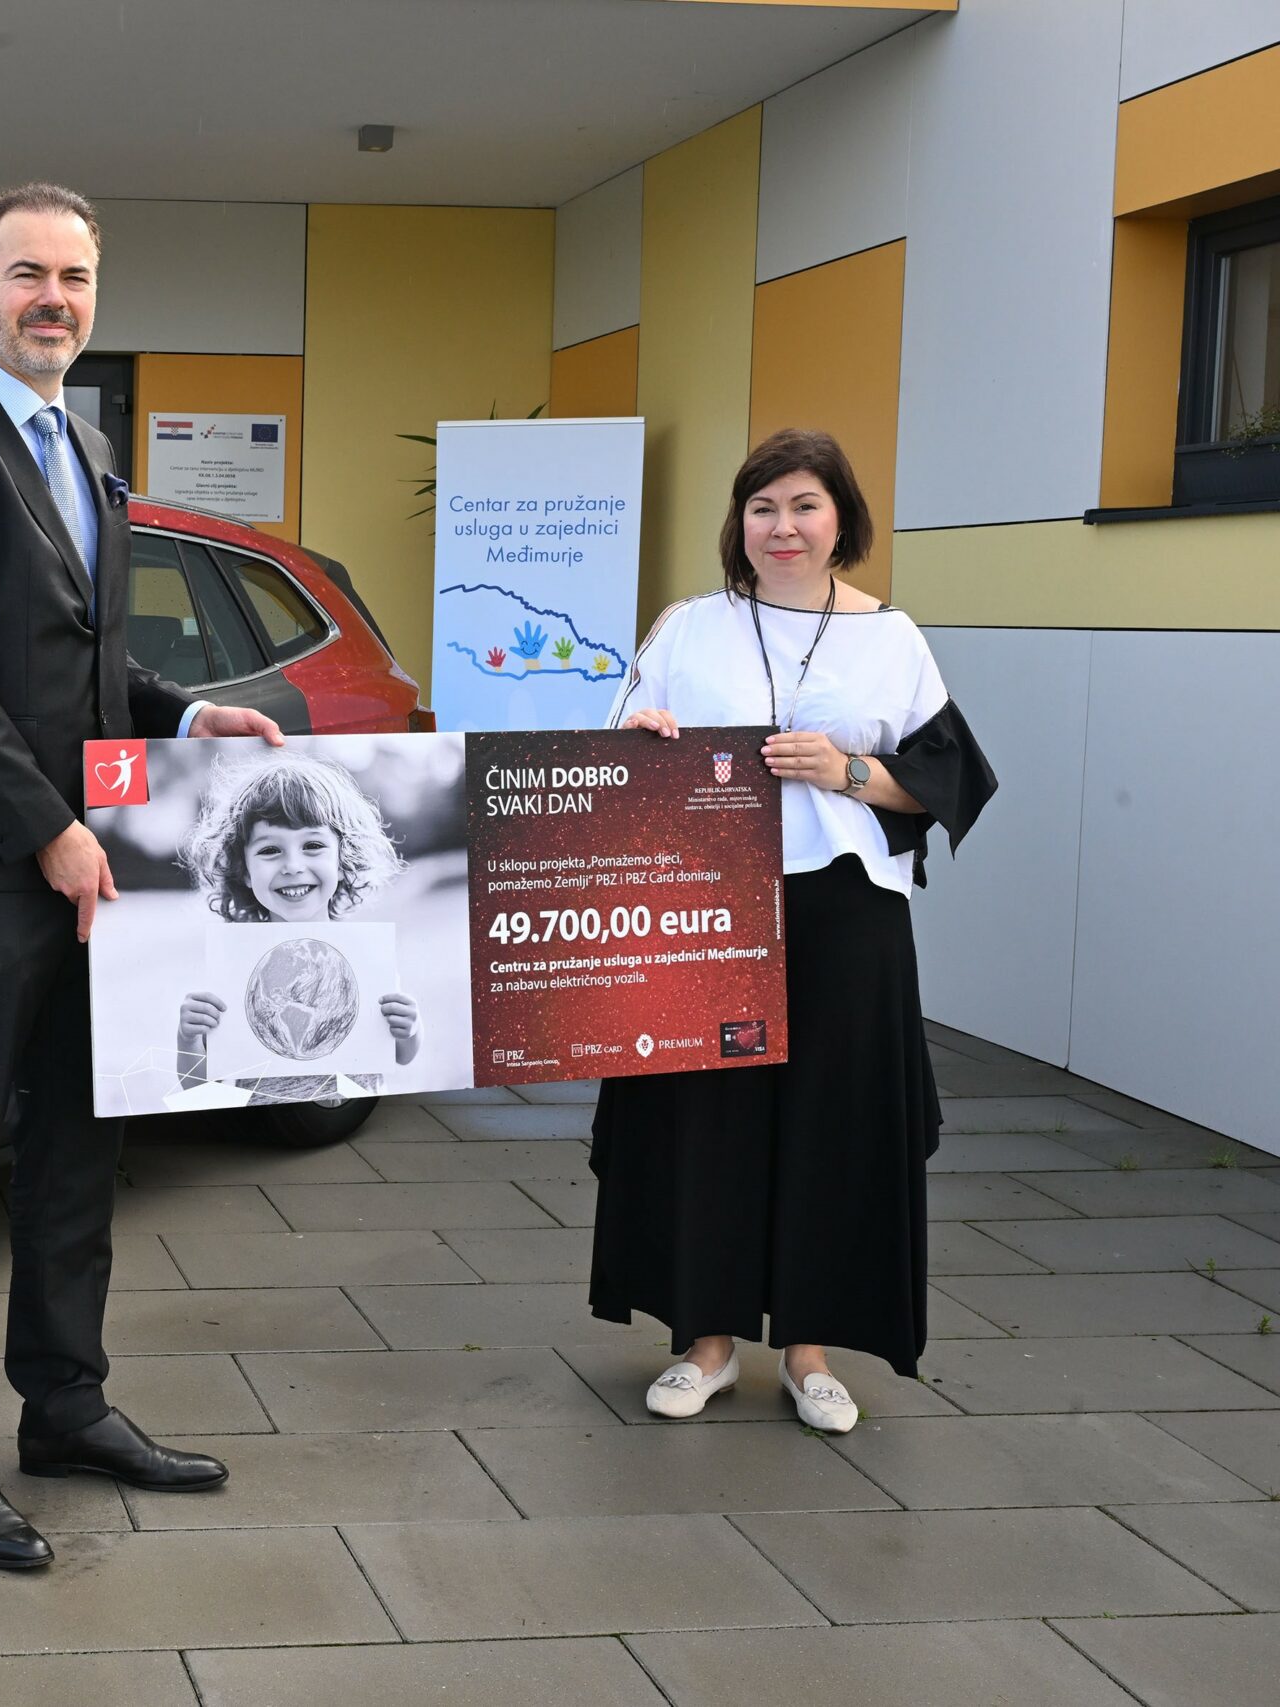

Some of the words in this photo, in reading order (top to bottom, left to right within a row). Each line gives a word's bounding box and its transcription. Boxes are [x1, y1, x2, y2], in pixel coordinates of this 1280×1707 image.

[449, 495, 510, 513] Centar
[516, 499, 538, 513] za
[544, 495, 626, 518] pružanje
[454, 518, 513, 541] usluga
[520, 523, 529, 536] u
[535, 517, 619, 541] zajednici
[486, 544, 584, 567] Međimurje
[485, 765, 546, 790] ČINIM
[551, 765, 629, 788] DOBRO
[486, 794, 542, 816] SVAKI
[548, 792, 592, 814] DAN
[487, 860, 496, 872] U
[499, 859, 537, 875] sklopu
[539, 857, 585, 874] projekta
[586, 854, 652, 870] „Pomažemo
[654, 852, 683, 867] djeci,
[488, 877, 551, 894] pomažemo
[596, 874, 617, 887] PBZ
[619, 873, 624, 885] i
[625, 872, 647, 884] PBZ
[649, 871, 674, 883] Card
[676, 868, 721, 883] doniraju
[488, 905, 651, 944] 49.700,00
[659, 906, 732, 936] eura
[490, 961, 531, 974] Centru
[533, 961, 547, 972] za
[549, 956, 601, 973] pružanje
[604, 954, 642, 968] usluga
[644, 955, 652, 964] u
[654, 949, 705, 966] zajednici
[707, 946, 768, 961] Međimurje
[490, 982, 503, 992] za
[506, 978, 547, 991] nabavu
[550, 974, 611, 988] električnog
[614, 970, 648, 984] vozila.
[506, 1050, 524, 1061] PBZ
[585, 1043, 602, 1054] PBZ
[658, 1038, 703, 1051] PREMIUM
